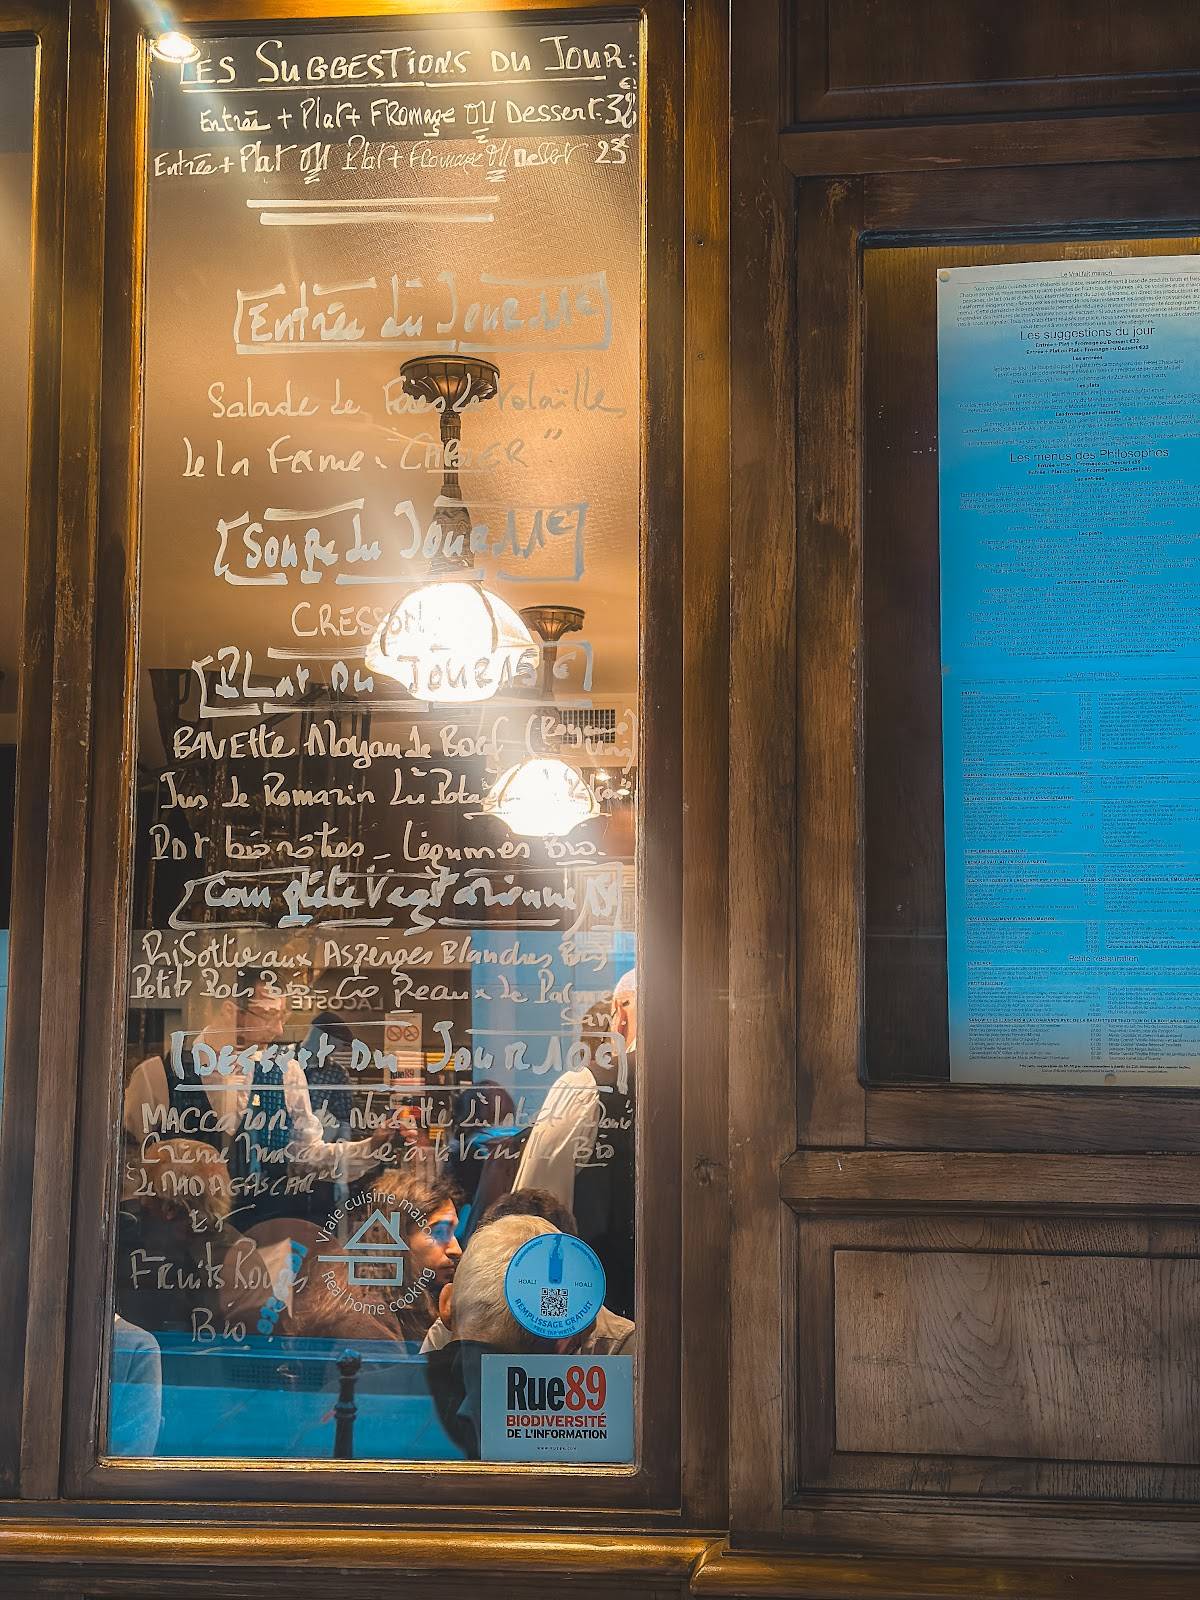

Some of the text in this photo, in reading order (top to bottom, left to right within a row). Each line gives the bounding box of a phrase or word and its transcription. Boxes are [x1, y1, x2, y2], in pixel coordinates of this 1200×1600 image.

[1020, 326, 1156, 341] Les suggestions du jour
[208, 377, 320, 418] Salade
[1010, 447, 1169, 464] Les menus des Philosophes
[315, 1207, 345, 1243] Vraie
[343, 1188, 396, 1211] cuisine
[321, 1267, 436, 1316] Real home cooking
[565, 1300, 593, 1326] GRATUIT
[507, 1365, 607, 1411] Rue89
[506, 1413, 607, 1428] BIODIVERSITÉ
[507, 1429, 607, 1440] DE L'INFORMATION
